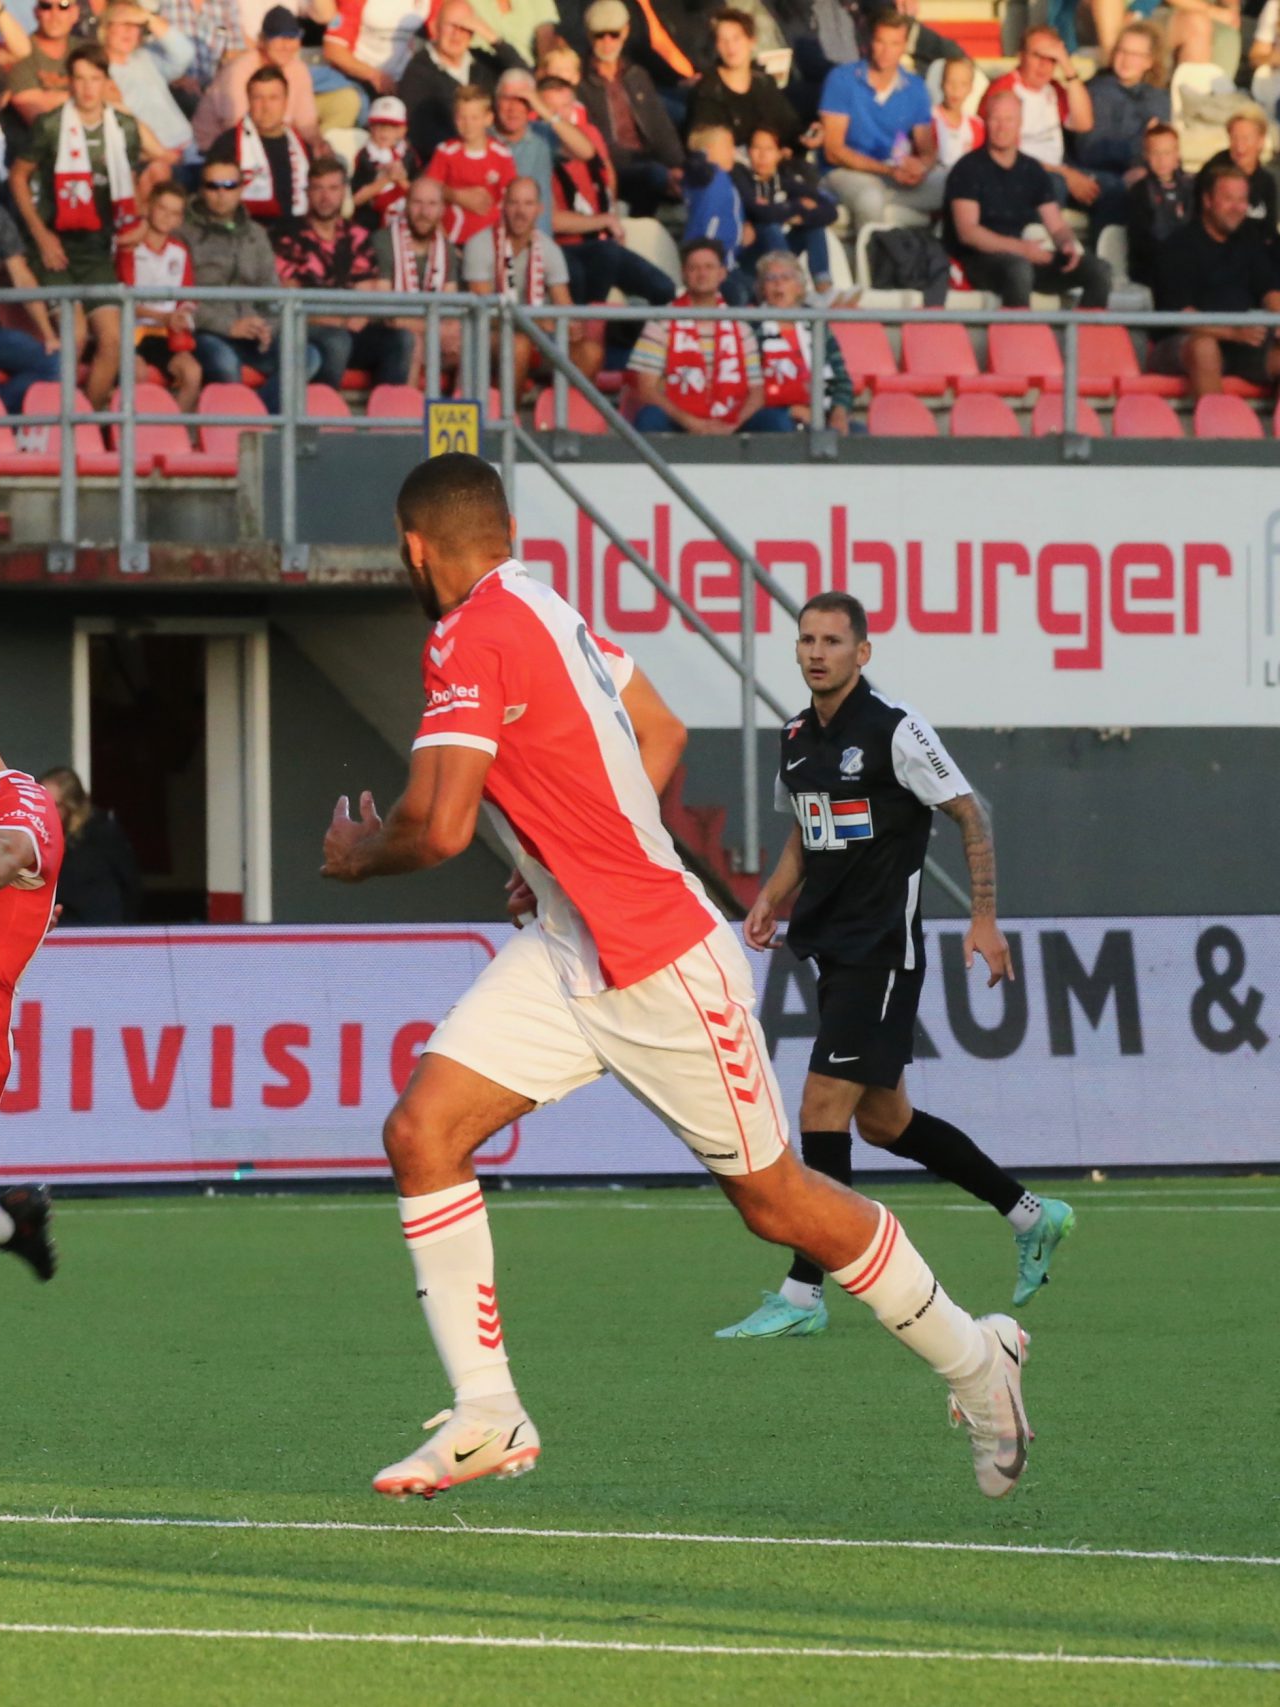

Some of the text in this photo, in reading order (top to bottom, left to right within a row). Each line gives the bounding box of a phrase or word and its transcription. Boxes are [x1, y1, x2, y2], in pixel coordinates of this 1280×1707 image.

[432, 409, 472, 425] VAK
[907, 721, 930, 748] SRP
[1190, 925, 1270, 1054] &
